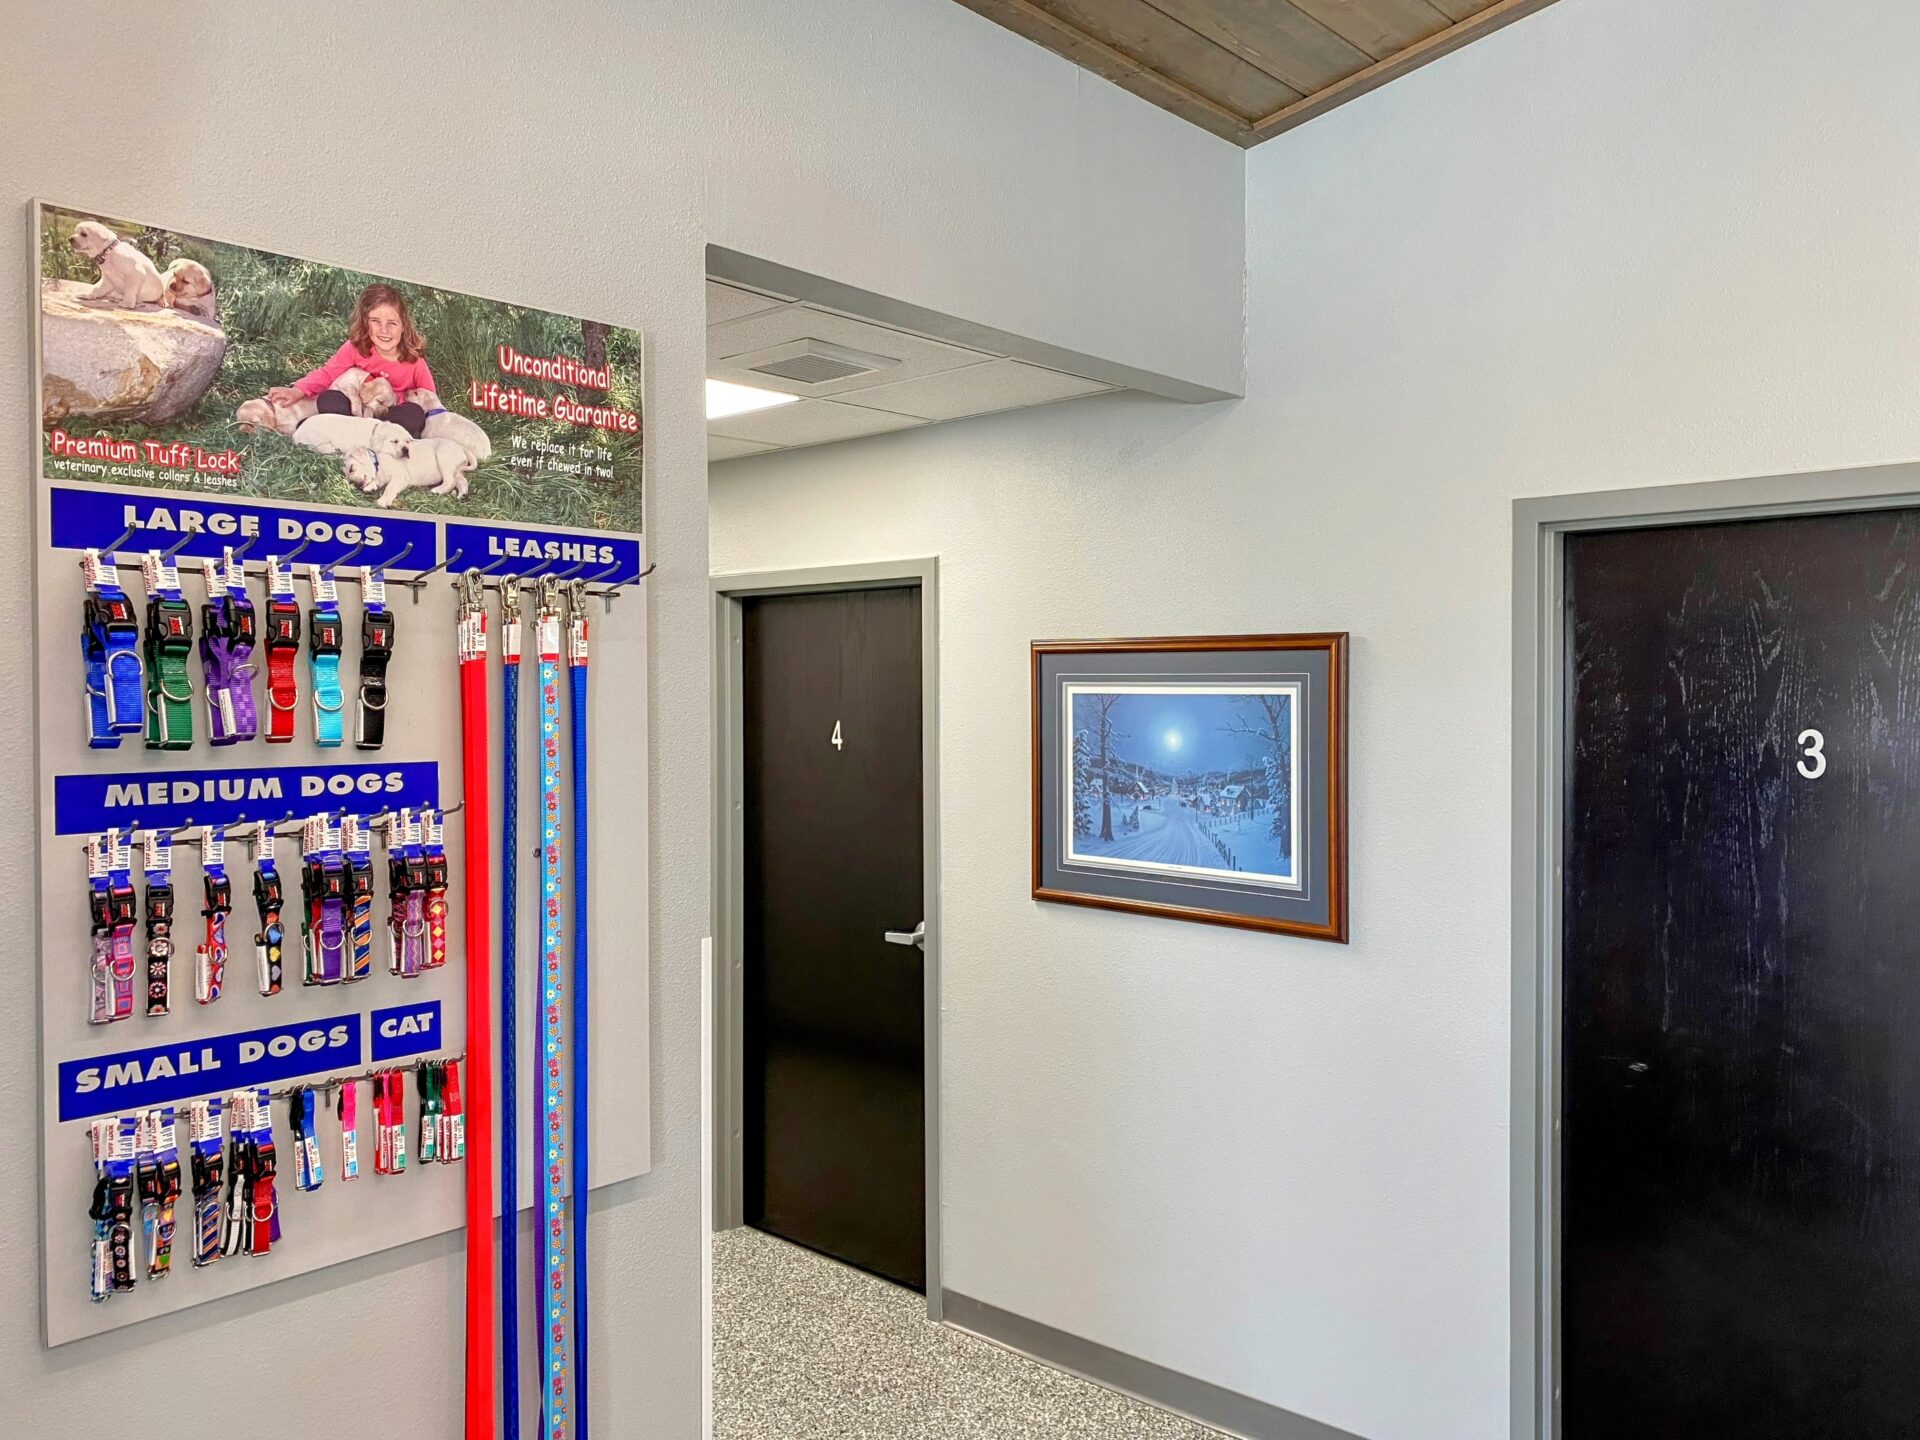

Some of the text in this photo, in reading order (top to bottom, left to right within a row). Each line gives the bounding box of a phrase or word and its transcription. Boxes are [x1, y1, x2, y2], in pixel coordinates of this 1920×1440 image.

[500, 343, 611, 390] Unconditional
[471, 380, 638, 431] Lifetime Guarantee
[54, 431, 238, 471] Premium Tuff Lock
[511, 433, 613, 462] We replace it for life
[53, 459, 238, 488] veterinary exclusive collars & leashes
[510, 456, 533, 469] even
[536, 456, 545, 470] if
[547, 457, 581, 475] chewed
[584, 462, 593, 476] in
[124, 505, 384, 546] LARGE DOGS
[488, 536, 615, 565] LEASHES
[831, 720, 843, 751] 4
[1796, 729, 1826, 779] 3
[104, 772, 404, 807] MEDIUM DOGS
[380, 1012, 434, 1038] CAT
[75, 1026, 349, 1093] SMALL DOGS
